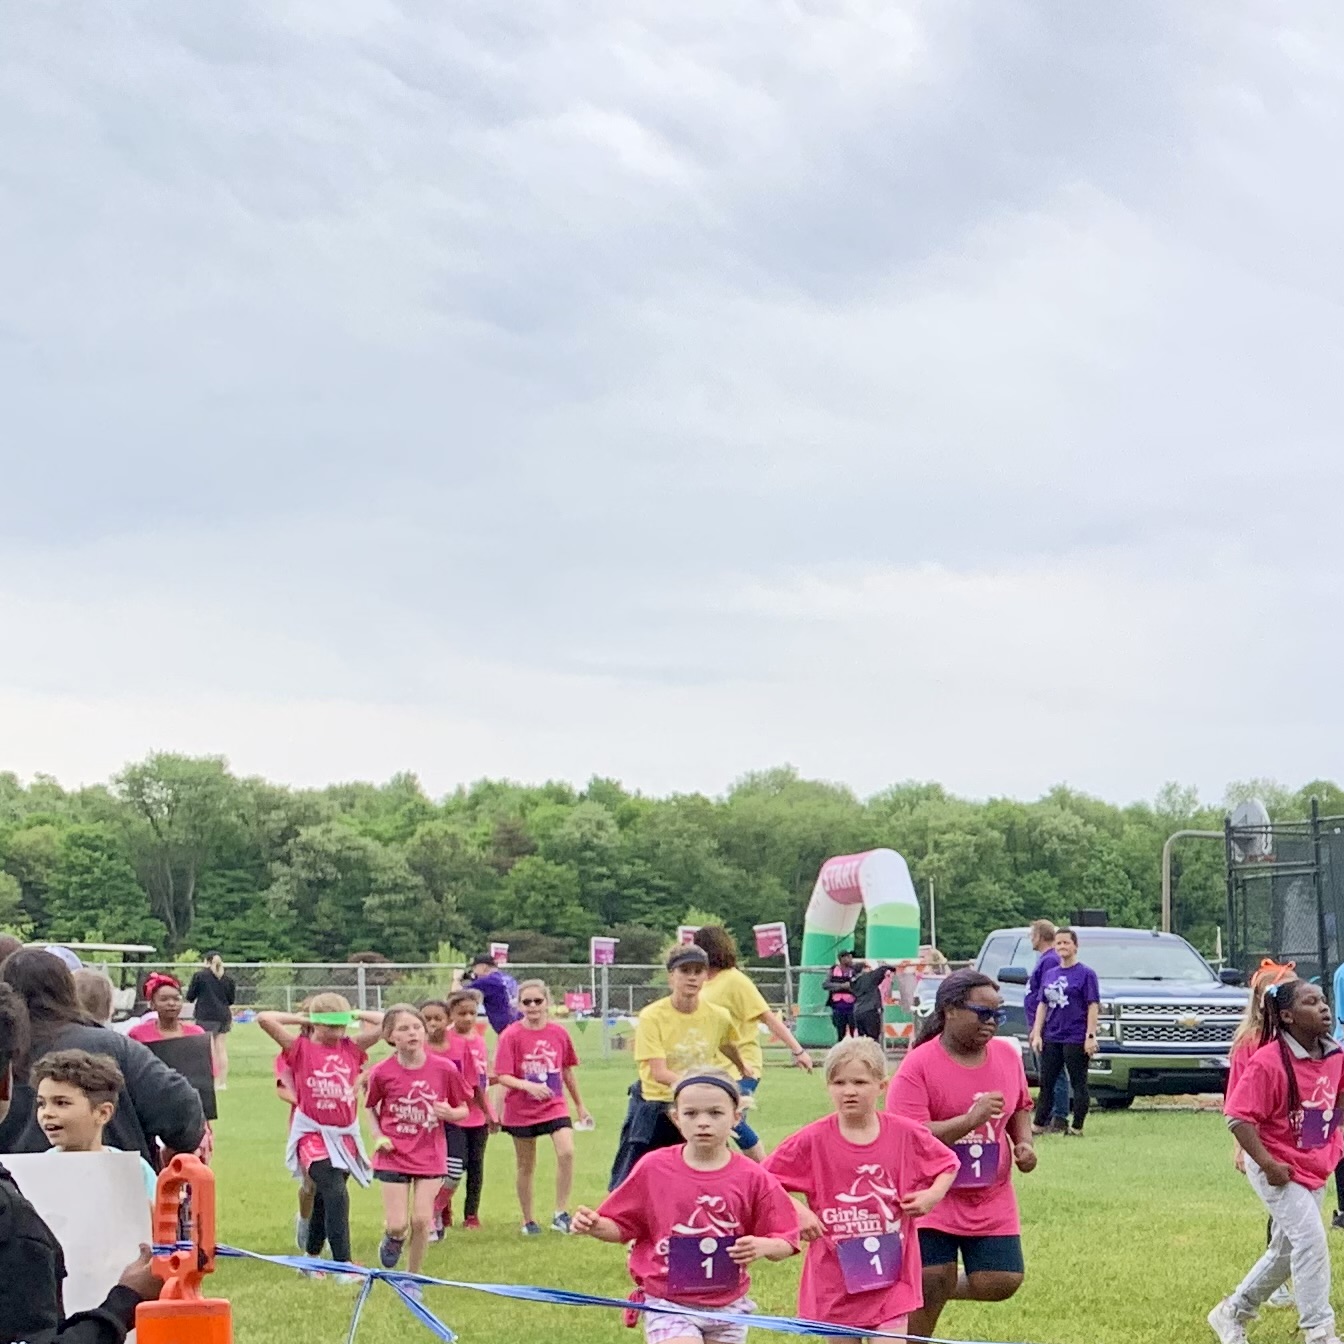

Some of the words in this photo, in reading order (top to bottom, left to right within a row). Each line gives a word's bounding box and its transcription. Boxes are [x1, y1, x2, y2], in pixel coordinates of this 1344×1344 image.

[1322, 1123, 1330, 1139] 1
[971, 1160, 981, 1178] 1
[822, 1206, 869, 1225] Girls
[845, 1219, 882, 1234] run
[701, 1256, 713, 1279] 1
[870, 1254, 883, 1275] 1
